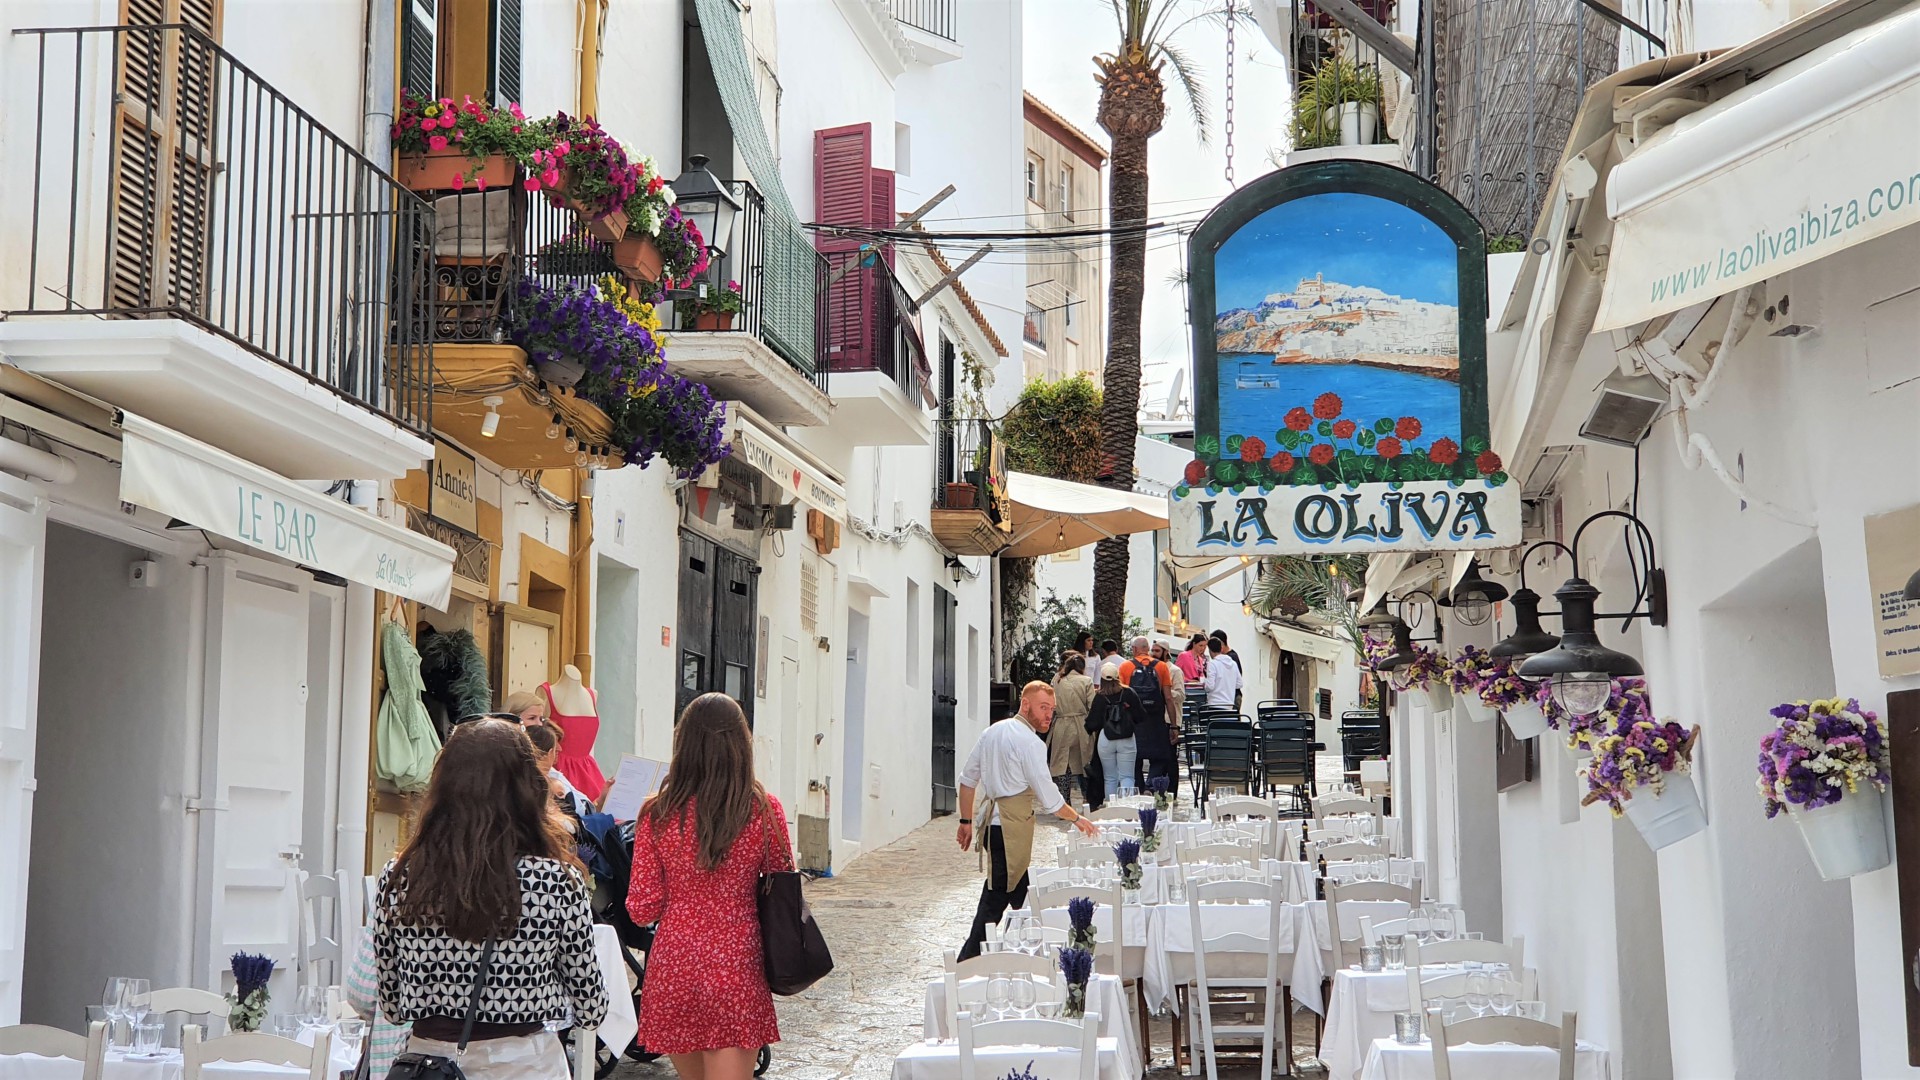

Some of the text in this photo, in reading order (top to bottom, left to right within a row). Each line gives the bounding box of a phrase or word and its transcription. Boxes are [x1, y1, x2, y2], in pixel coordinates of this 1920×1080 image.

[435, 458, 474, 504] Annie's
[811, 483, 837, 510] BOUTIQUE
[238, 486, 319, 564] LE BAR
[616, 517, 623, 538] 7
[1197, 490, 1497, 547] LA OLIVA
[375, 552, 408, 588] La Oliva
